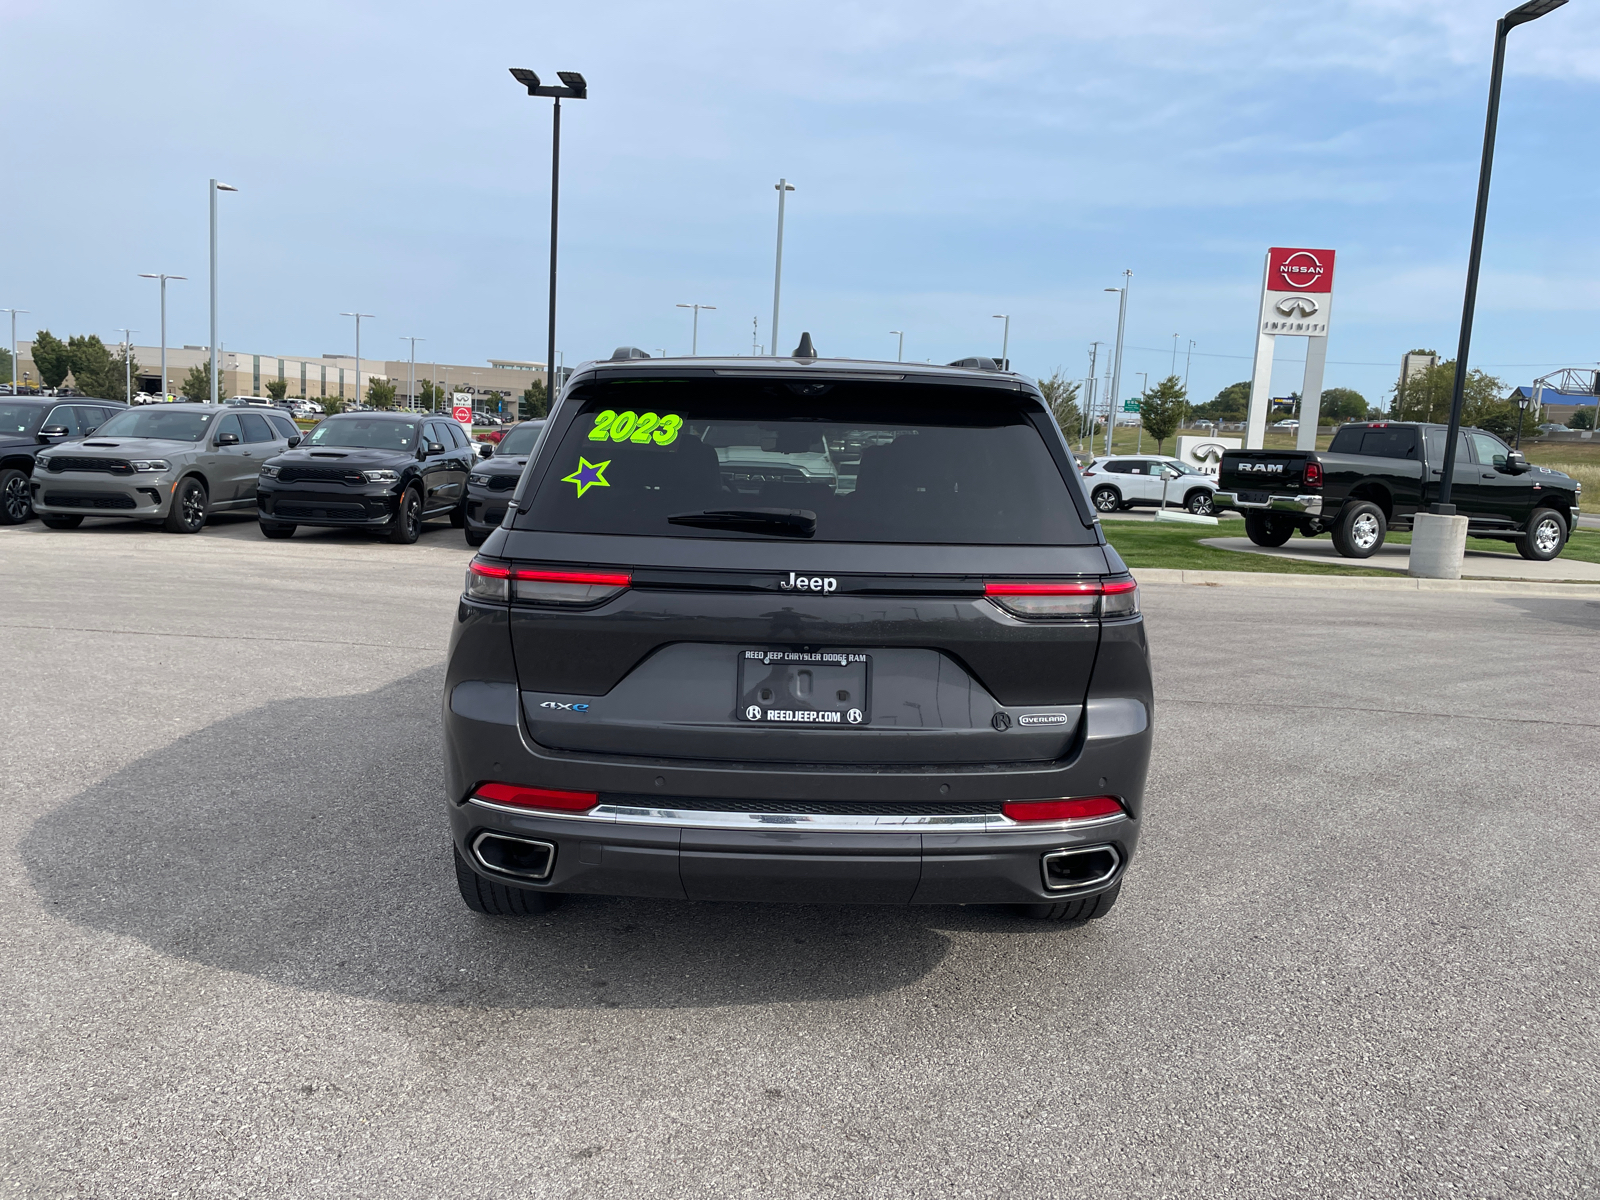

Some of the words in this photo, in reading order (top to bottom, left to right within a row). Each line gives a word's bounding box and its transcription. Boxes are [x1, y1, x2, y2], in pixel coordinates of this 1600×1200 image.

[1280, 265, 1324, 274] NISSAN
[1264, 321, 1326, 332] INFINITI
[588, 409, 683, 446] 2023
[1238, 463, 1283, 472] RAM
[780, 572, 837, 595] Jeep
[745, 650, 764, 659] REED
[766, 651, 783, 660] JEEP
[784, 652, 822, 661] CHRYSLER
[822, 653, 847, 662] DODGE
[848, 654, 867, 662] RAM
[767, 709, 841, 723] REEDJEEP.COM
[1022, 715, 1065, 723] OVERLAND
